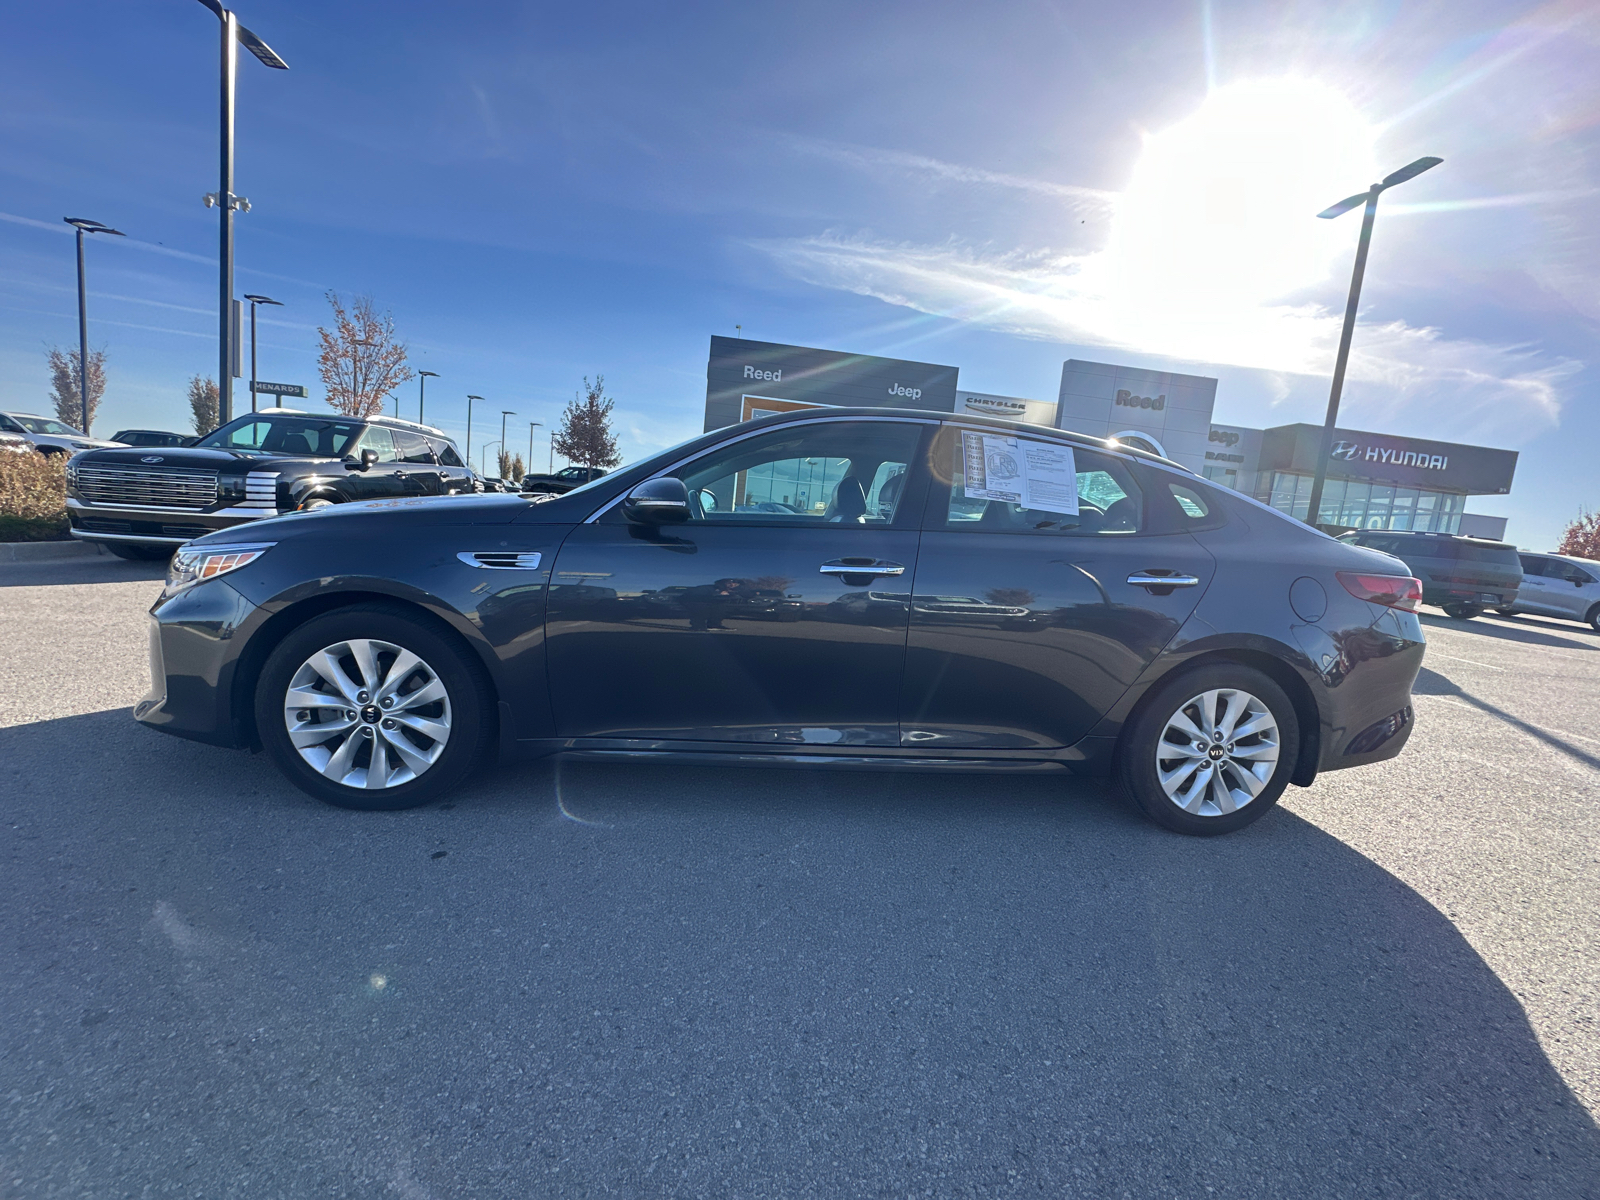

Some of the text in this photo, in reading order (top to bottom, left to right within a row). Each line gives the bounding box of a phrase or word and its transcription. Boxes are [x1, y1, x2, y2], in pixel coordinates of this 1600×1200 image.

[743, 365, 782, 382] Reed
[255, 383, 300, 393] MENARDS
[888, 383, 922, 399] Jeep
[966, 397, 1026, 410] CHRYSLER
[1115, 389, 1166, 411] Reed
[1208, 430, 1240, 447] eep
[1365, 446, 1448, 470] HYUNDAI
[366, 707, 375, 722] KIA
